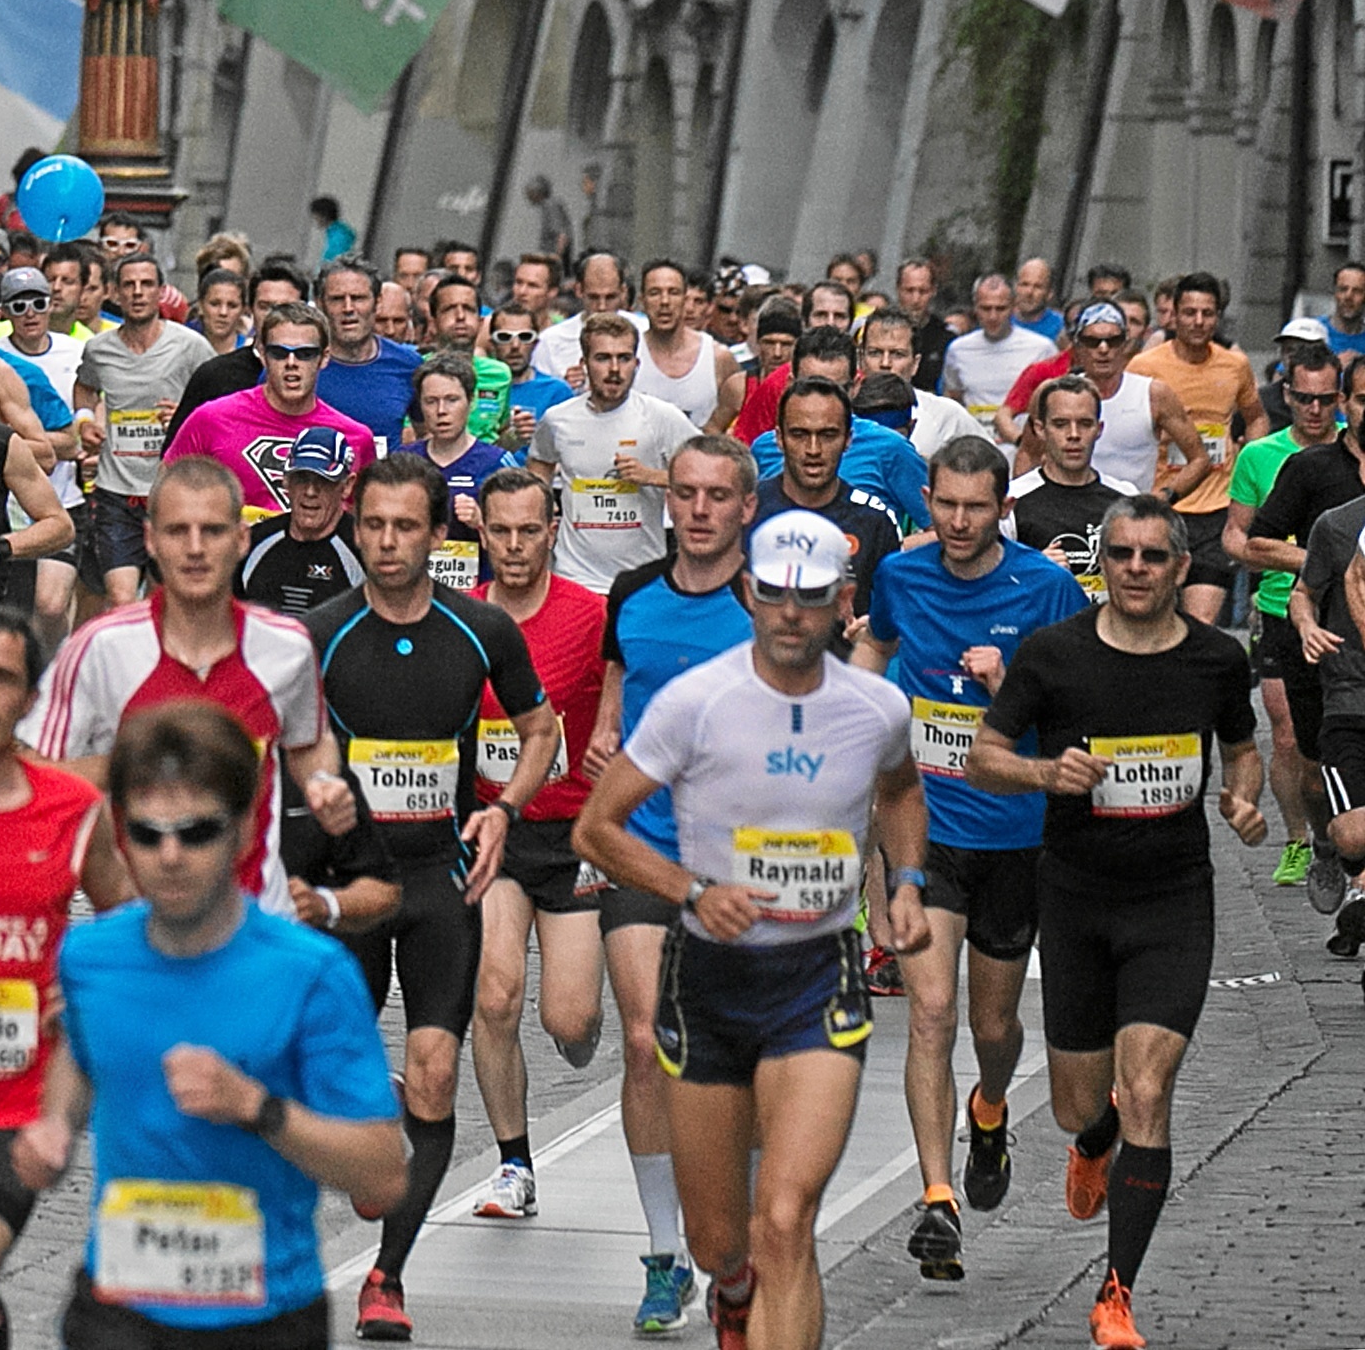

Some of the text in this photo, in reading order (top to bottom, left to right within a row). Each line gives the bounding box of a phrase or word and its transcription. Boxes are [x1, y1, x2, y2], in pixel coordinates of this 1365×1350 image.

[593, 495, 617, 508] Tim
[607, 511, 637, 522] 7410
[775, 528, 818, 556] sky
[932, 709, 977, 721] DIE POST
[395, 751, 423, 759] POST
[1136, 745, 1164, 756] POST
[765, 744, 825, 783] sky
[1114, 762, 1183, 783] Lothar
[370, 766, 438, 787] Tobias
[406, 791, 449, 810] 6510
[1140, 784, 1194, 805] 18919
[749, 857, 844, 888] Raynald
